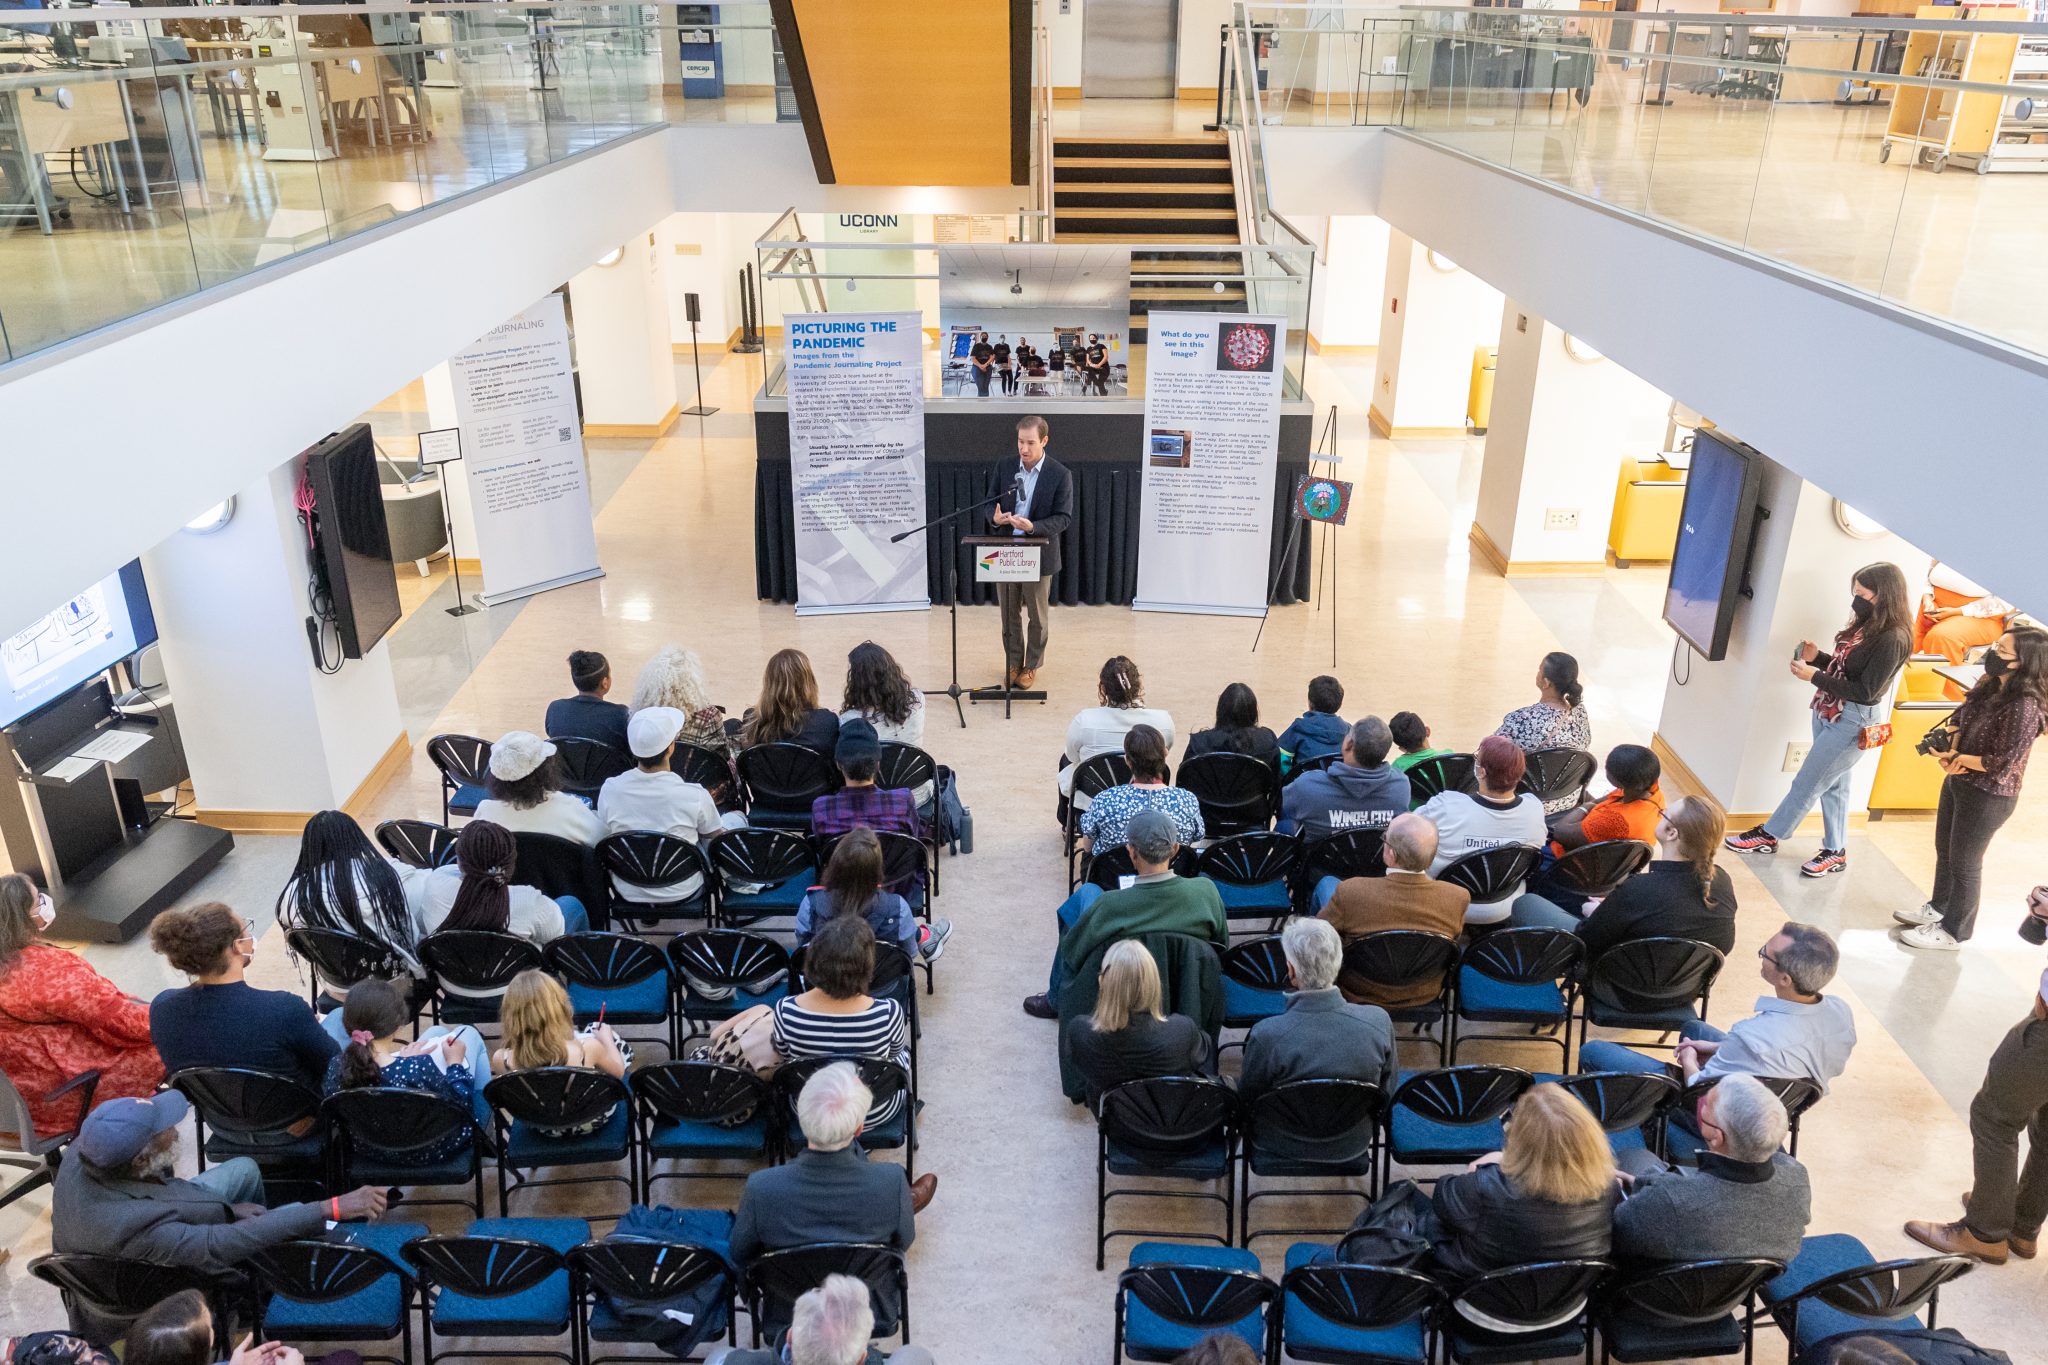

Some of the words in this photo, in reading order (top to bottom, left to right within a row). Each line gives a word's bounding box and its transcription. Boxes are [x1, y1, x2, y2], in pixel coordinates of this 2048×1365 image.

[840, 214, 898, 227] UCONN
[792, 322, 865, 334] PICTURING
[870, 322, 896, 332] THE
[792, 337, 864, 349] PANDEMIC
[876, 360, 902, 368] Project
[1018, 559, 1036, 568] Library
[1466, 838, 1499, 848] United
